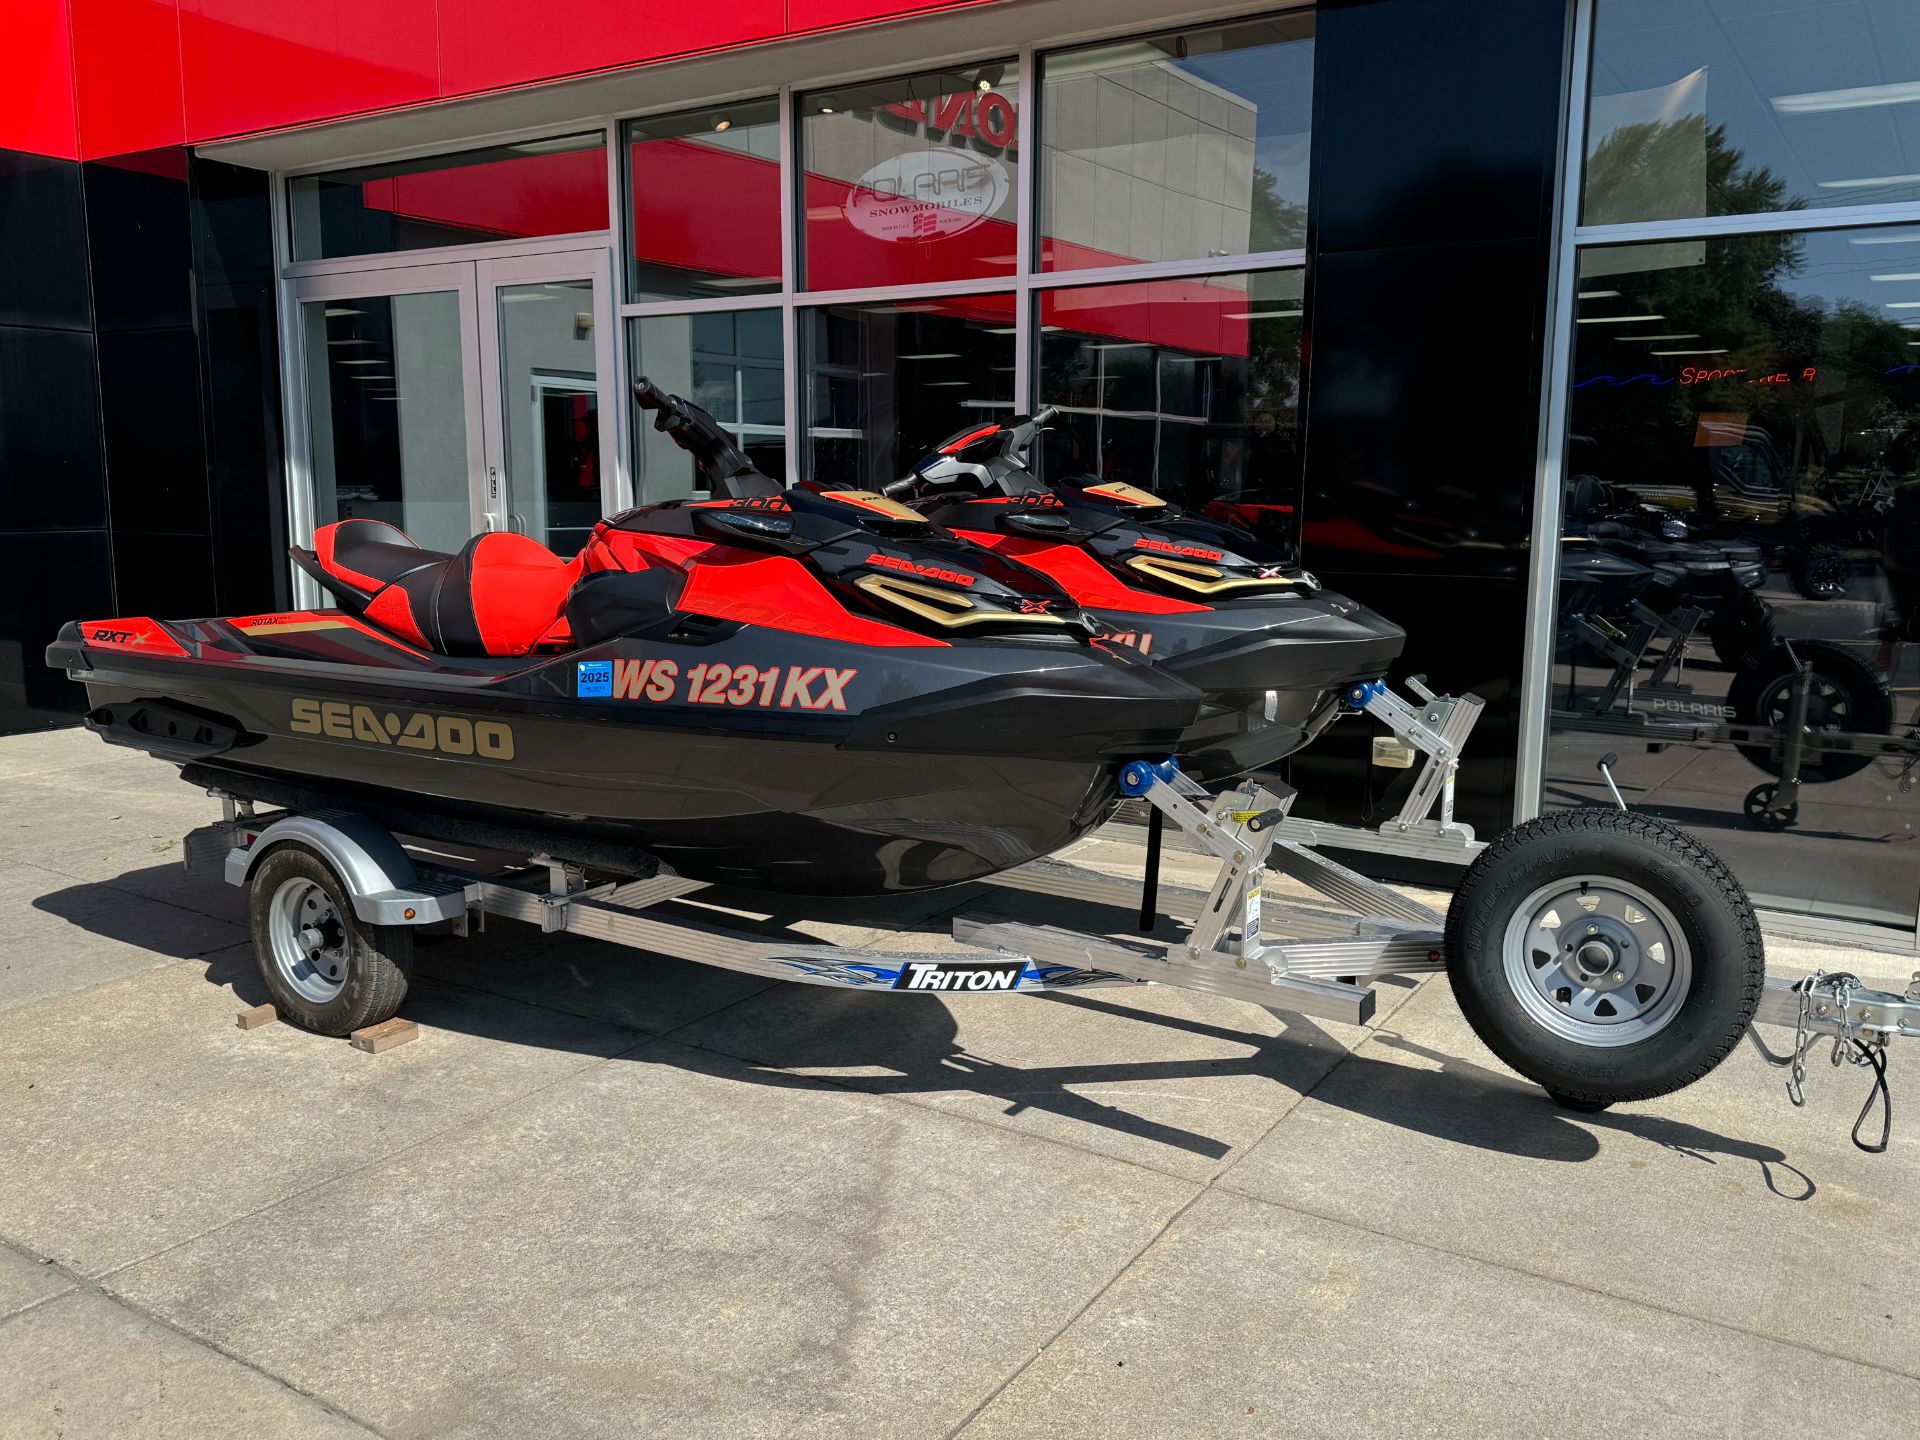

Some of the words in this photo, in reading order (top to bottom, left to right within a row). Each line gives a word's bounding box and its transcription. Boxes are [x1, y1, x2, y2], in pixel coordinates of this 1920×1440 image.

[869, 196, 983, 218] SNOWMOBILES
[251, 616, 279, 627] ROTAX
[580, 671, 610, 683] 2025
[612, 658, 679, 702] WS
[1653, 698, 1737, 719] POLARIS
[907, 963, 1018, 990] TRITON
